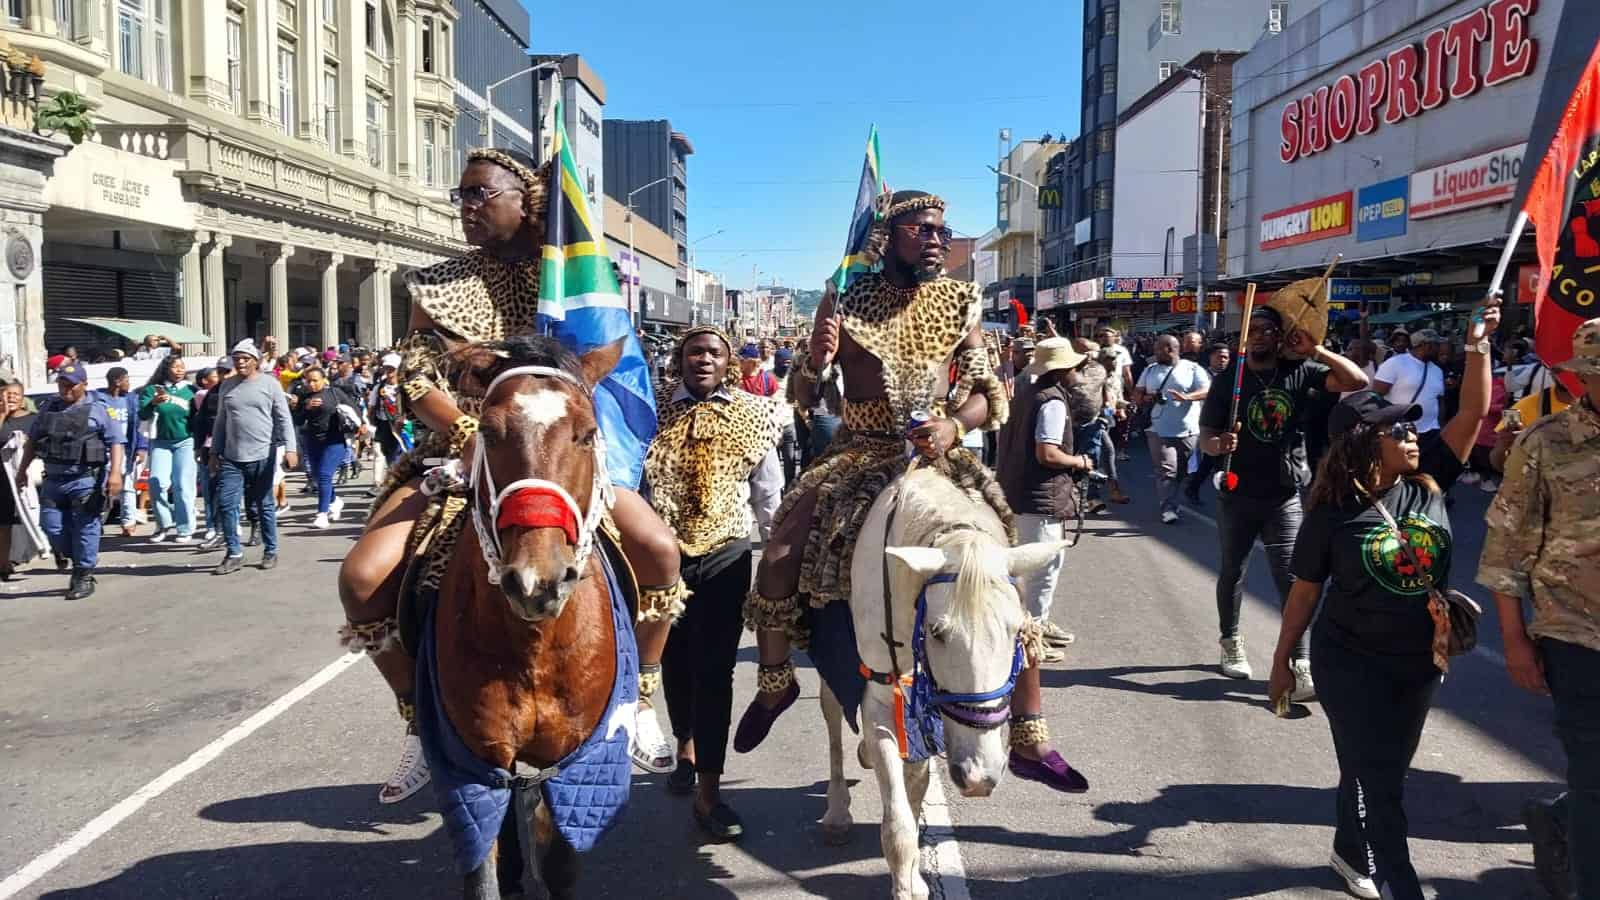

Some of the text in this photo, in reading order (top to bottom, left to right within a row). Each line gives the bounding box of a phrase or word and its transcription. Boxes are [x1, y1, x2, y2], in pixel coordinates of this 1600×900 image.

[1280, 0, 1536, 163] SHOPRITE
[1432, 153, 1523, 204] LiquorSho
[1261, 200, 1346, 243] HUNGRY LION
[1363, 202, 1381, 223] PEP
